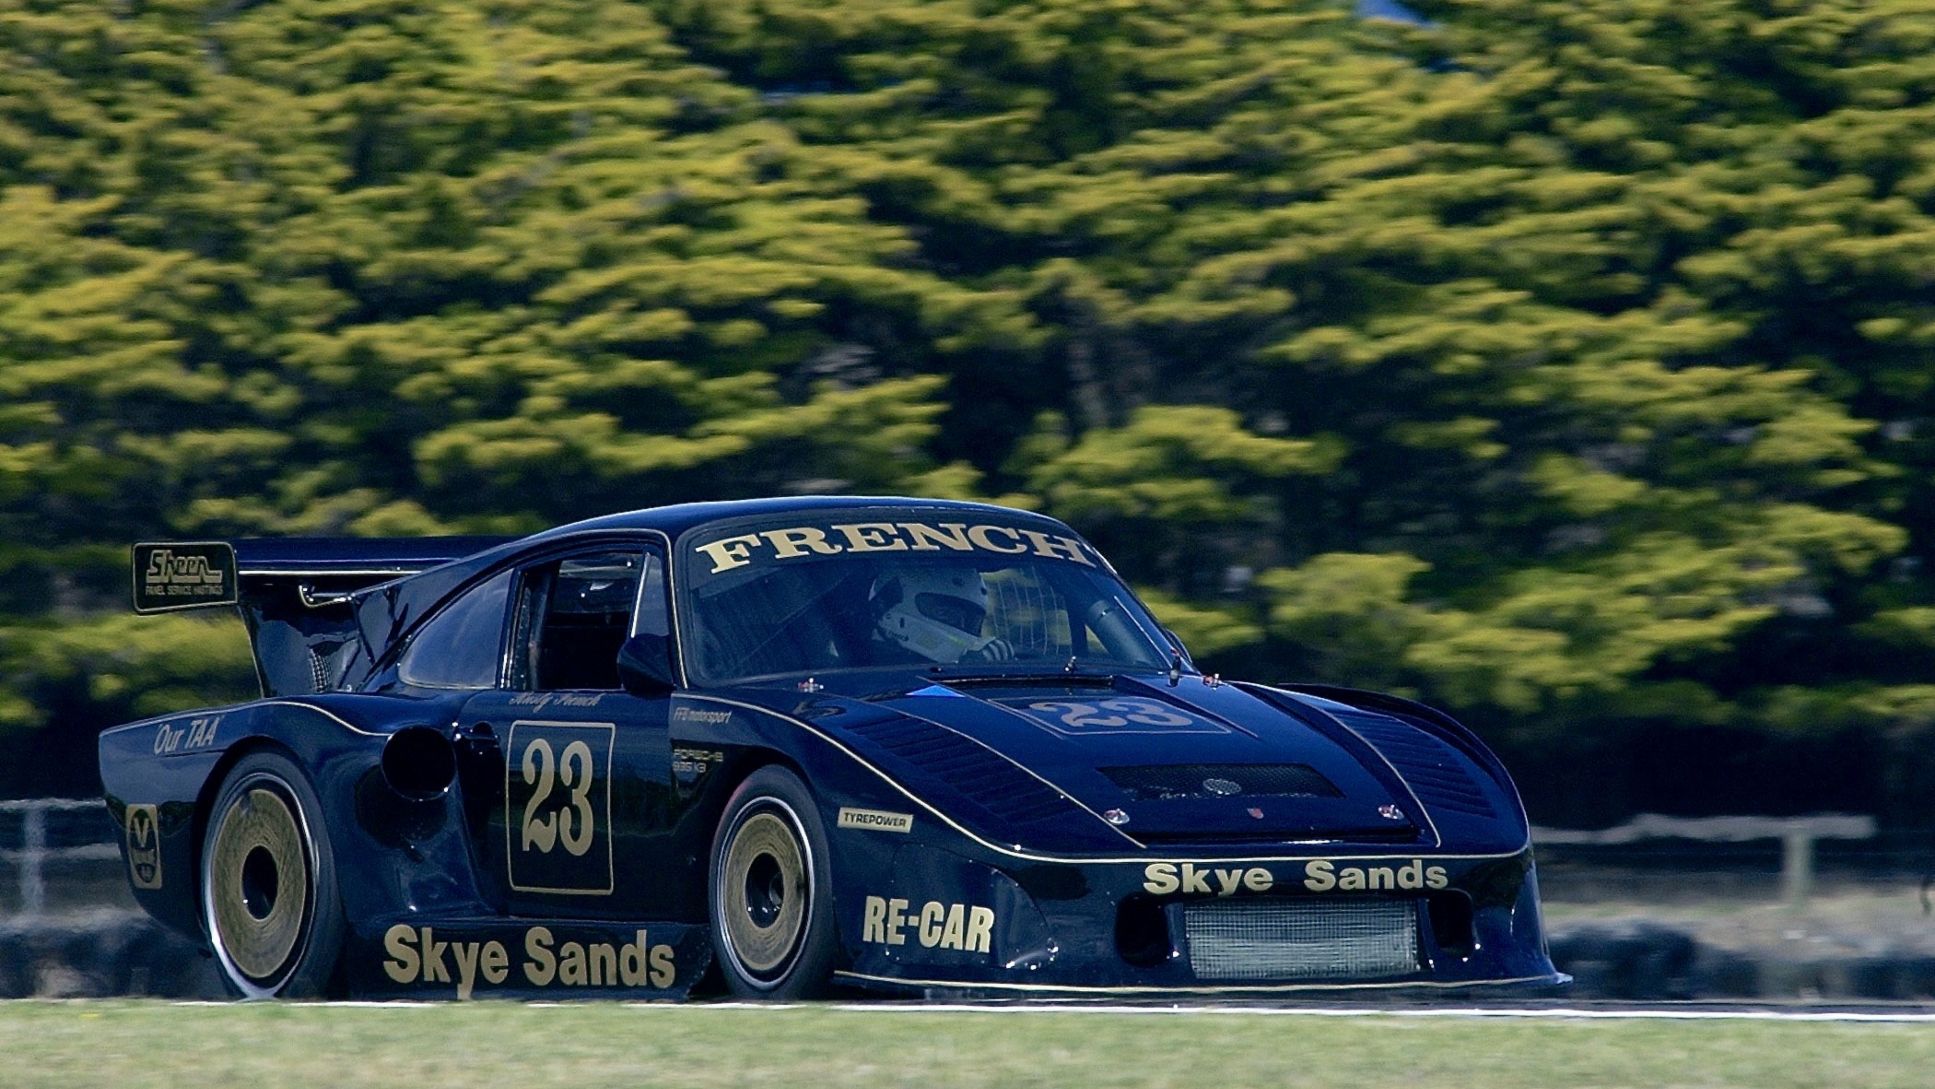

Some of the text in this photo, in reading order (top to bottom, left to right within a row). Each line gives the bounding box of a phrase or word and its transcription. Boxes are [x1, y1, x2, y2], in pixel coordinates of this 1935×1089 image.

[695, 522, 1097, 574] FRENCH
[1029, 700, 1193, 727] 23
[522, 738, 594, 857] 23
[844, 812, 907, 828] TYREPOWER
[1143, 859, 1449, 897] Skye Sands
[862, 895, 995, 954] RE-CAR
[383, 923, 676, 1001] Skye Sands
